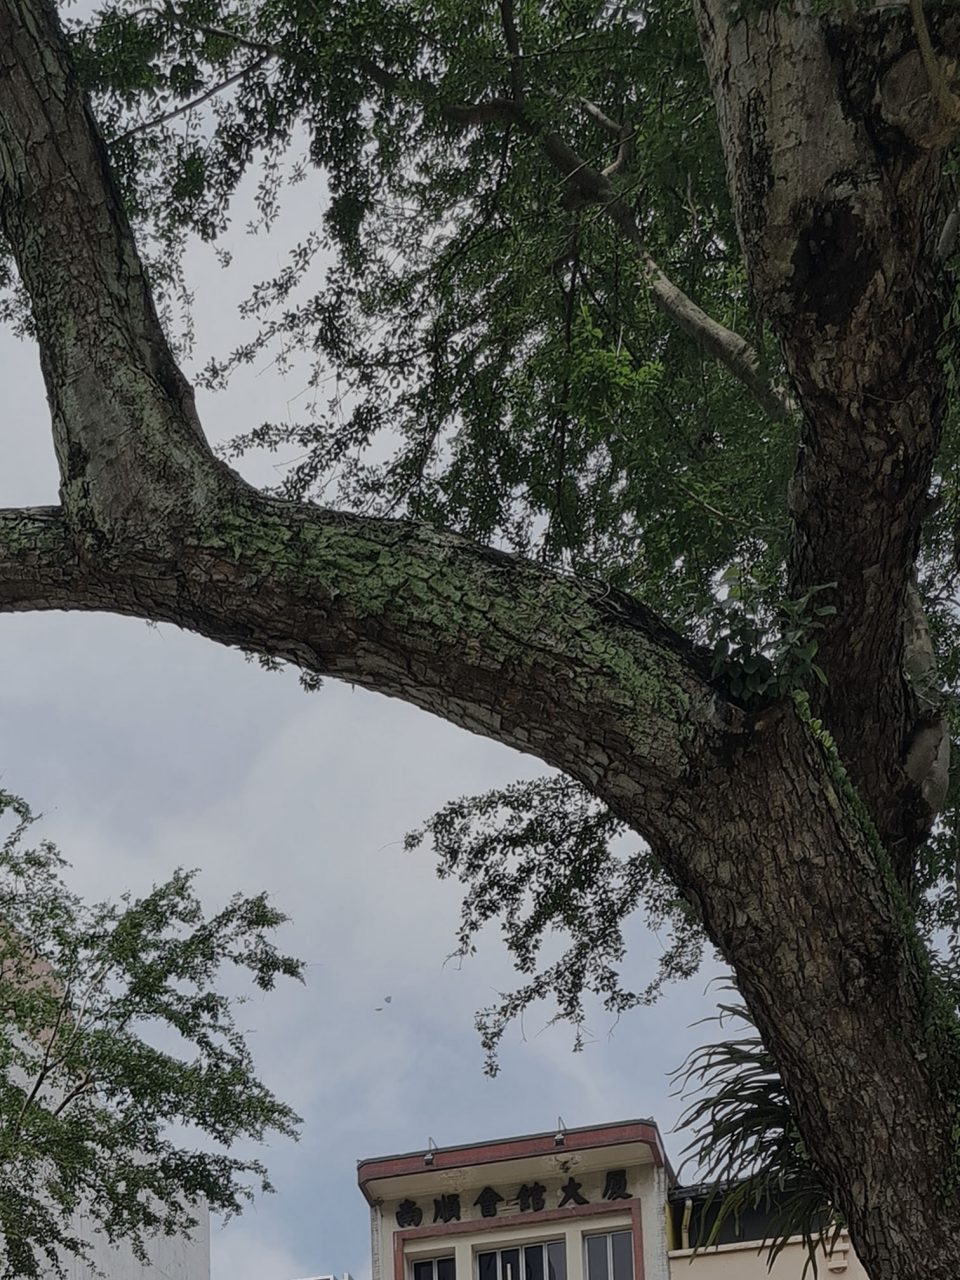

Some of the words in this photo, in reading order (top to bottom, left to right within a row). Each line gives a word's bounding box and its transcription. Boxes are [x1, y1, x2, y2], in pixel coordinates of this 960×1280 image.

[396, 1169, 633, 1228] 南順會館大廈
